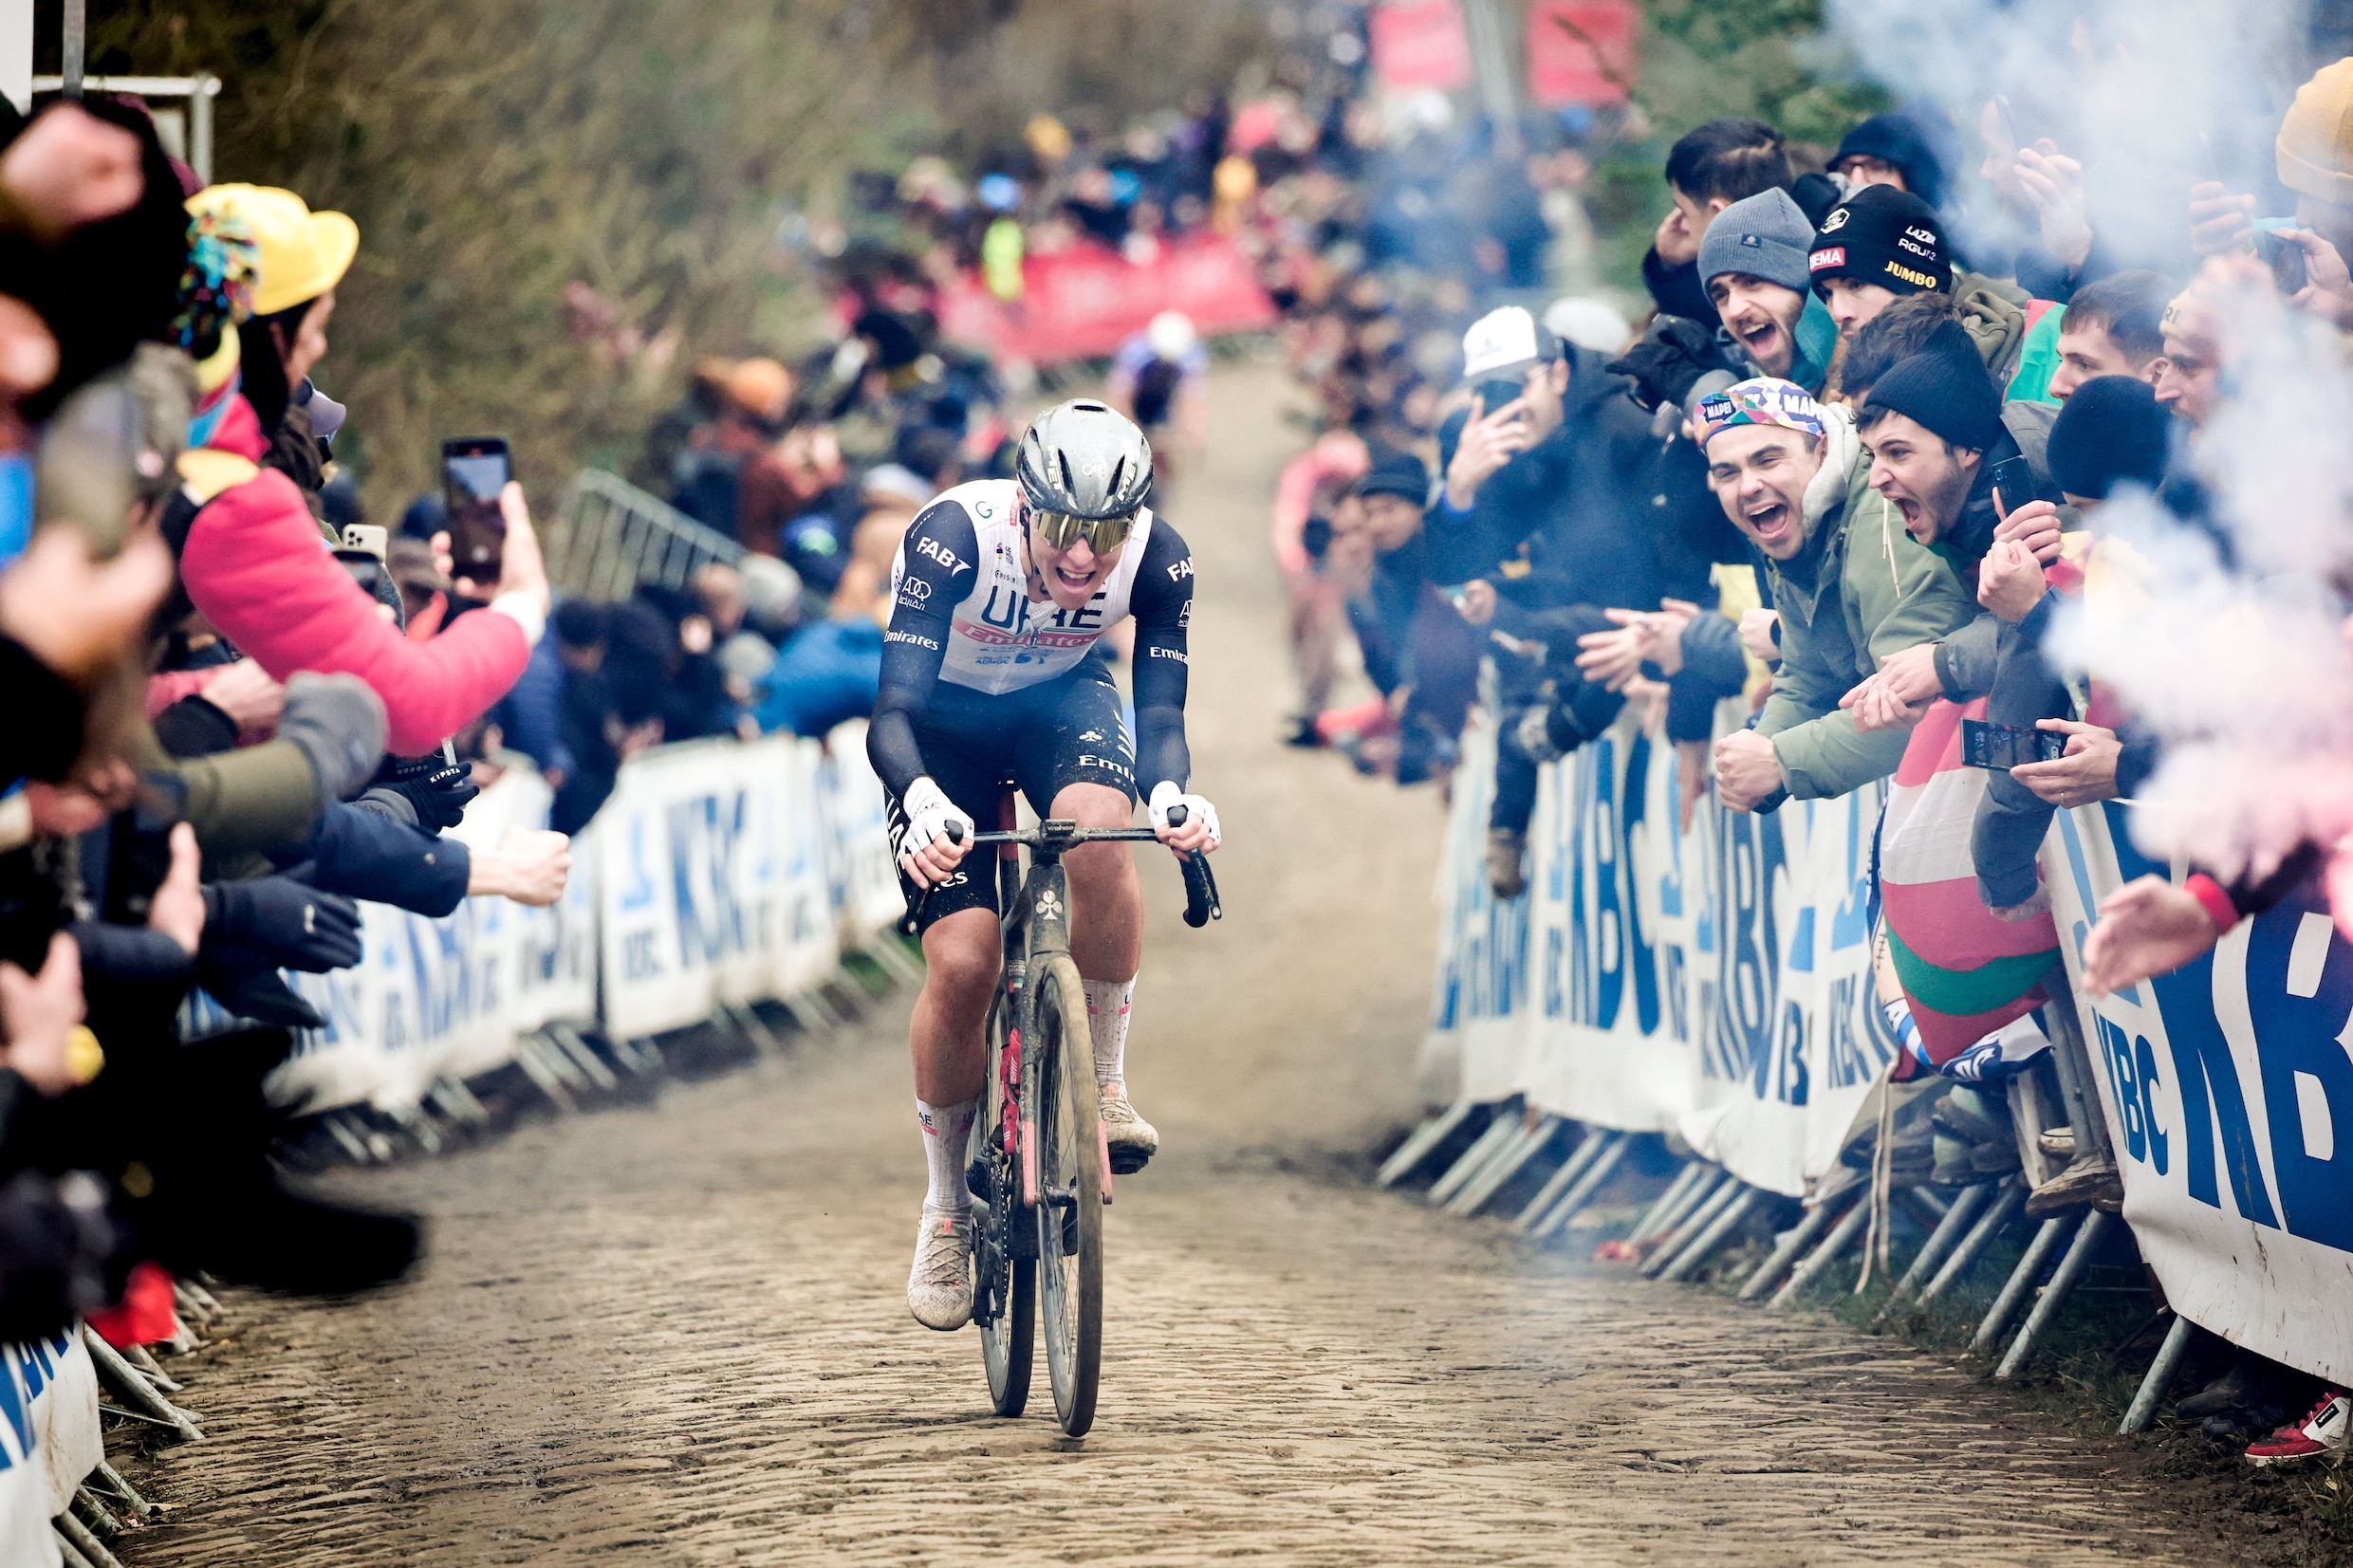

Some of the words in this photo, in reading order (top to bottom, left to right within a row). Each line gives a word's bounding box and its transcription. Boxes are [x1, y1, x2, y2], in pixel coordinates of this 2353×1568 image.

[1905, 225, 1936, 246] LAZER
[1884, 260, 1936, 288] JUMBO
[1707, 400, 1732, 418] MAPEI
[1047, 444, 1065, 494] MET
[1116, 449, 1138, 501] ME
[901, 575, 932, 601] ADQ
[981, 585, 1106, 636] UAE
[883, 630, 939, 652] Emirates
[429, 767, 461, 784] KIPSTA
